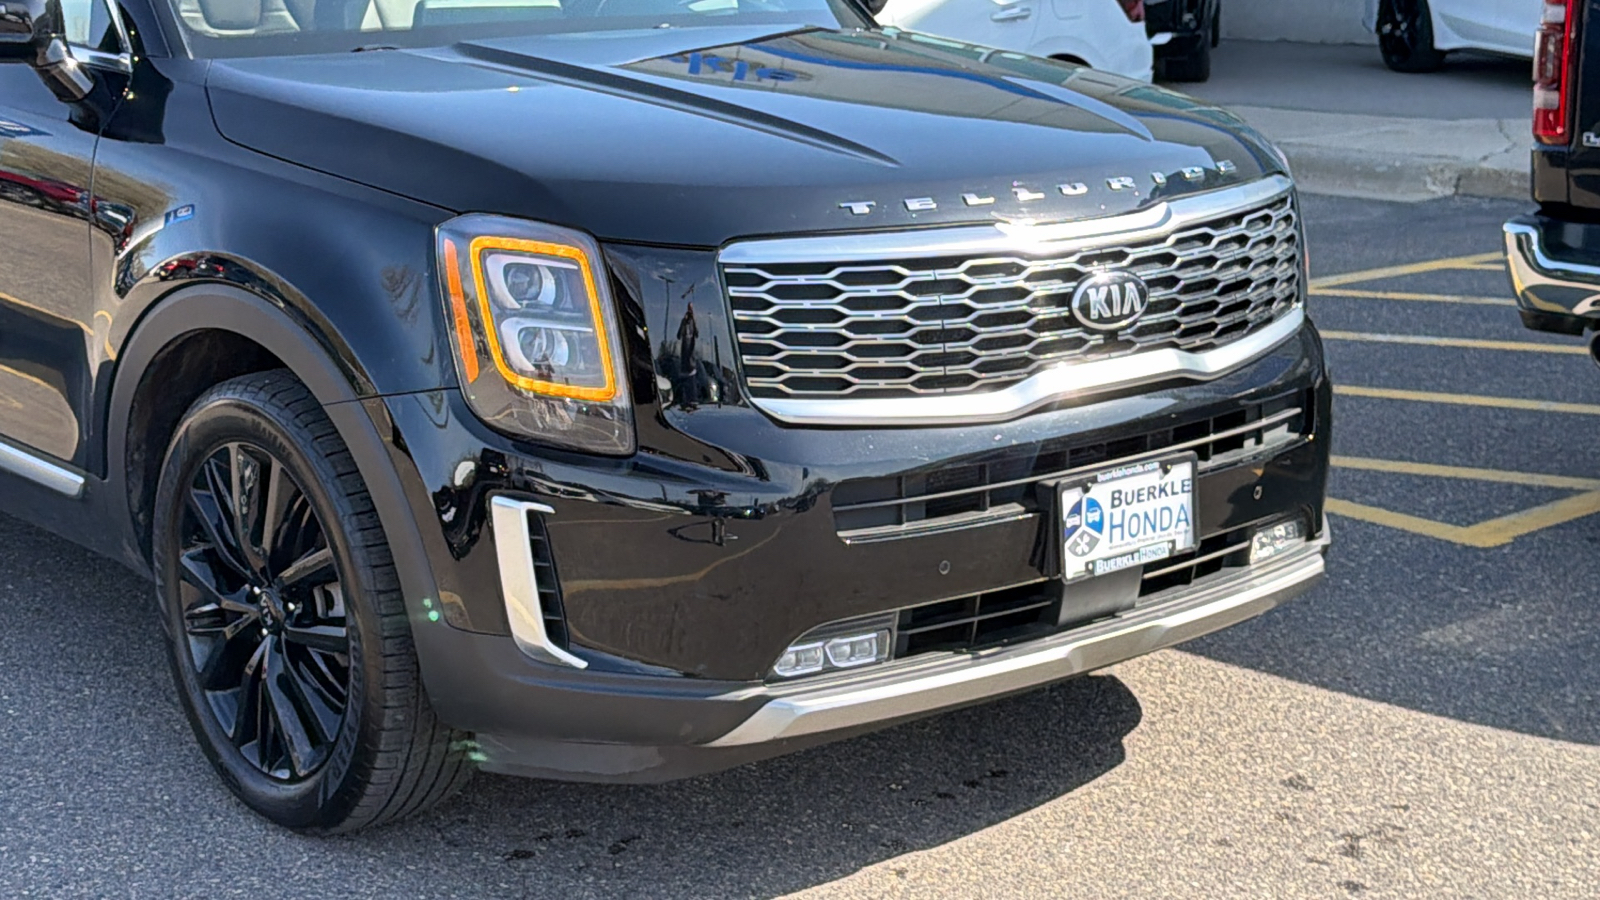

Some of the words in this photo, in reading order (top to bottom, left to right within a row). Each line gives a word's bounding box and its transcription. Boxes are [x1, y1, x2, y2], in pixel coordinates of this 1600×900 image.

[838, 159, 1237, 215] TELLURIDE
[1086, 282, 1141, 319] KIA
[1110, 478, 1192, 509] BUERKLE
[1109, 503, 1190, 543] HONDA
[1096, 551, 1140, 573] BUERKLE
[1141, 546, 1167, 562] HONDA
